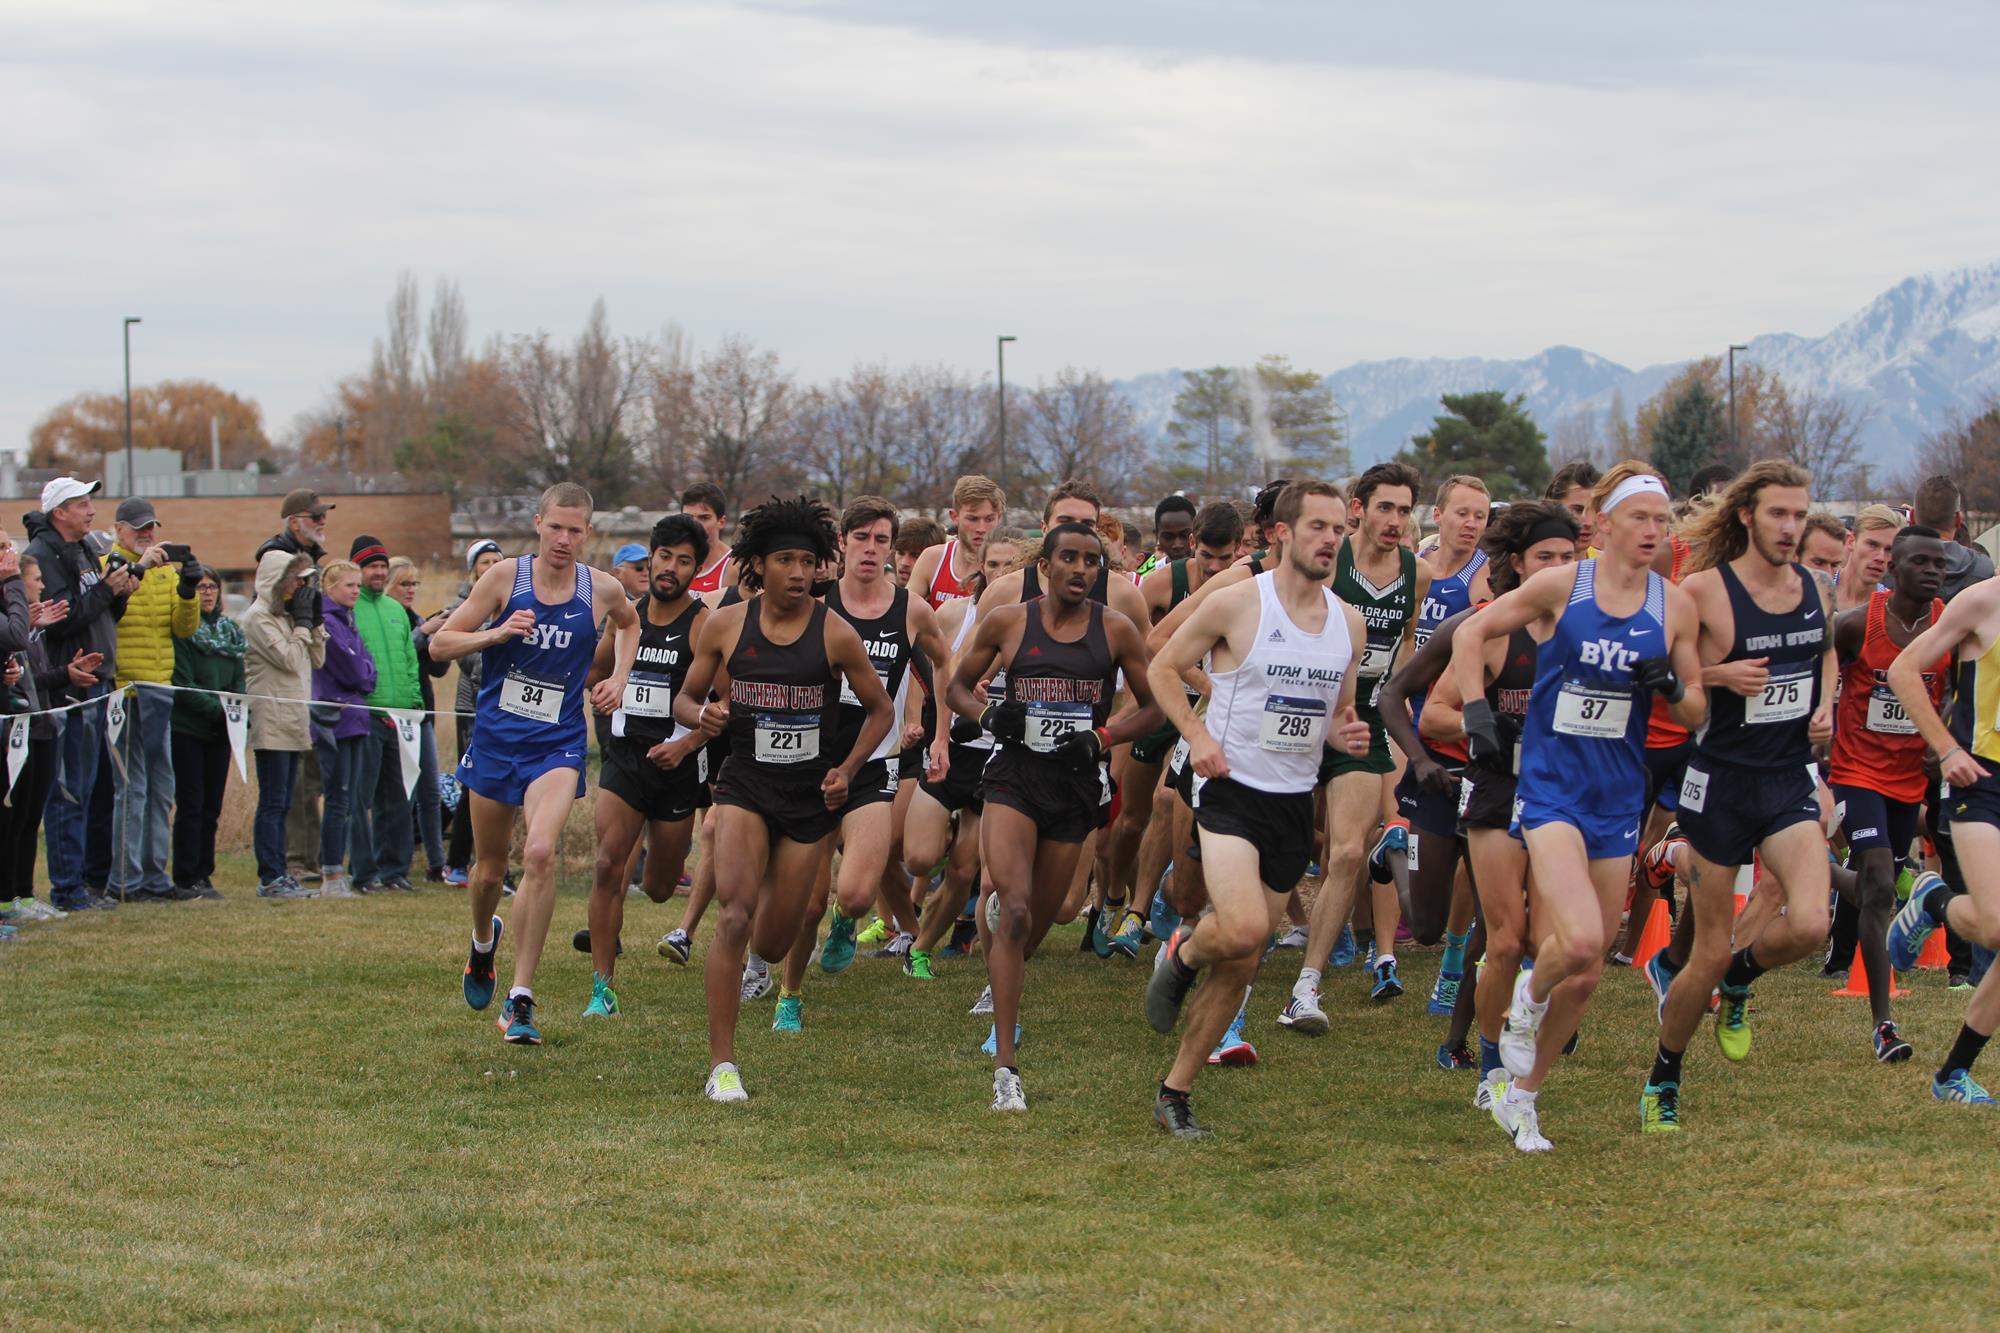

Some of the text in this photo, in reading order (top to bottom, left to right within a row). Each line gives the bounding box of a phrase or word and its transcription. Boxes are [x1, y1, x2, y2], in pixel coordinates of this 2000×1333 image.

[1352, 604, 1403, 620] OLORADO
[1419, 597, 1447, 621] YU
[1365, 616, 1389, 629] TATE
[522, 624, 573, 650] BYU
[1746, 628, 1823, 652] UTAH STATE
[636, 646, 679, 665] LORADO
[863, 639, 899, 658] RADO
[1579, 638, 1640, 672] BYU
[1266, 664, 1302, 678] UTAH
[1014, 677, 1075, 702] SOUTHERN
[1280, 678, 1305, 686] TRACK
[521, 685, 544, 706] 34
[635, 687, 651, 704] 61
[731, 679, 825, 710] SOUTHERN UTAH
[1498, 688, 1532, 715] SOUT
[1764, 682, 1799, 706] 275
[1581, 698, 1608, 720] 37
[1040, 719, 1076, 738] 225
[1278, 715, 1312, 737] 293
[771, 731, 802, 750] 221
[1683, 780, 1702, 801] 275
